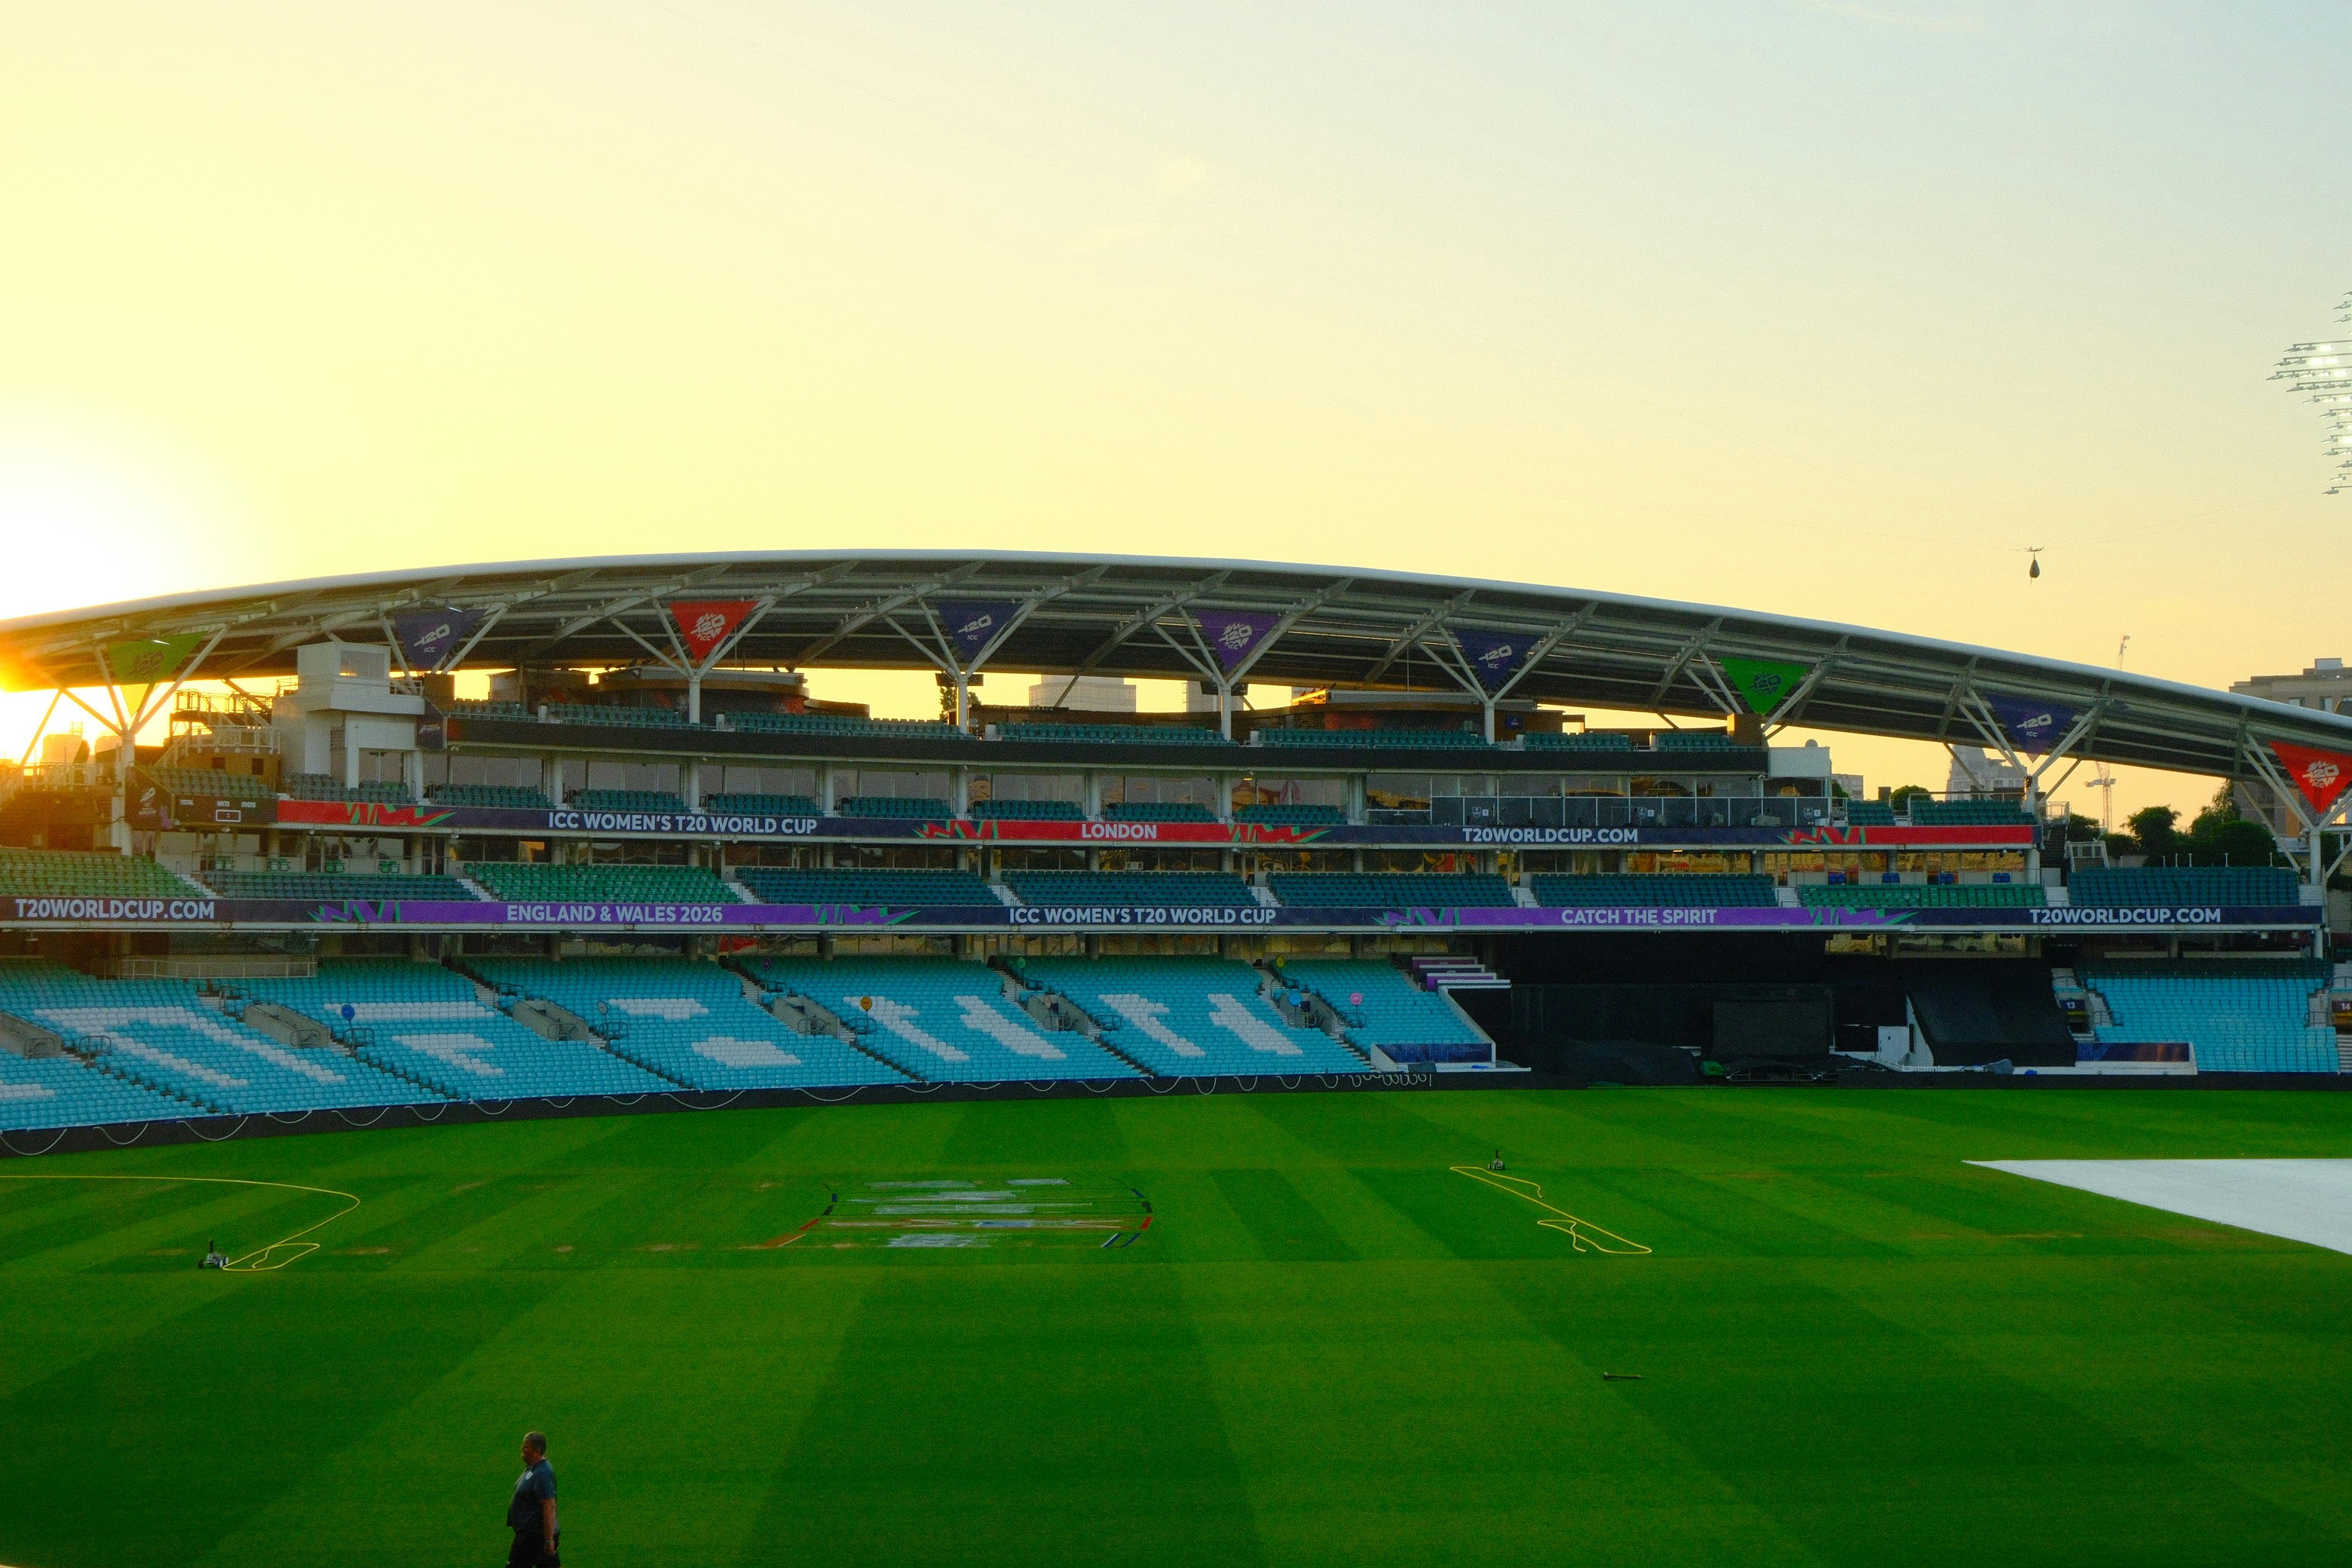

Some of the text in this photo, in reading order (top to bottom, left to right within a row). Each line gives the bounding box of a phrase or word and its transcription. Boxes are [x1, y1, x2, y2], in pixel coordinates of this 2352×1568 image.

[549, 812, 818, 835] ICC WOMEN'S T20 WORLD CUP
[1081, 823, 1158, 839] LONDON
[1462, 828, 1639, 844] T20WORLDCUP.COM
[15, 899, 215, 920] T20WORLDCUP.COM
[507, 905, 723, 923] ENGLAND & WALES 2026
[1009, 908, 1277, 924] ICC WOMEN'S T20 WORLD CUP
[1561, 909, 1717, 924] CATCH THE SPIRIT
[2029, 908, 2221, 924] T20WORLDCUP.COM
